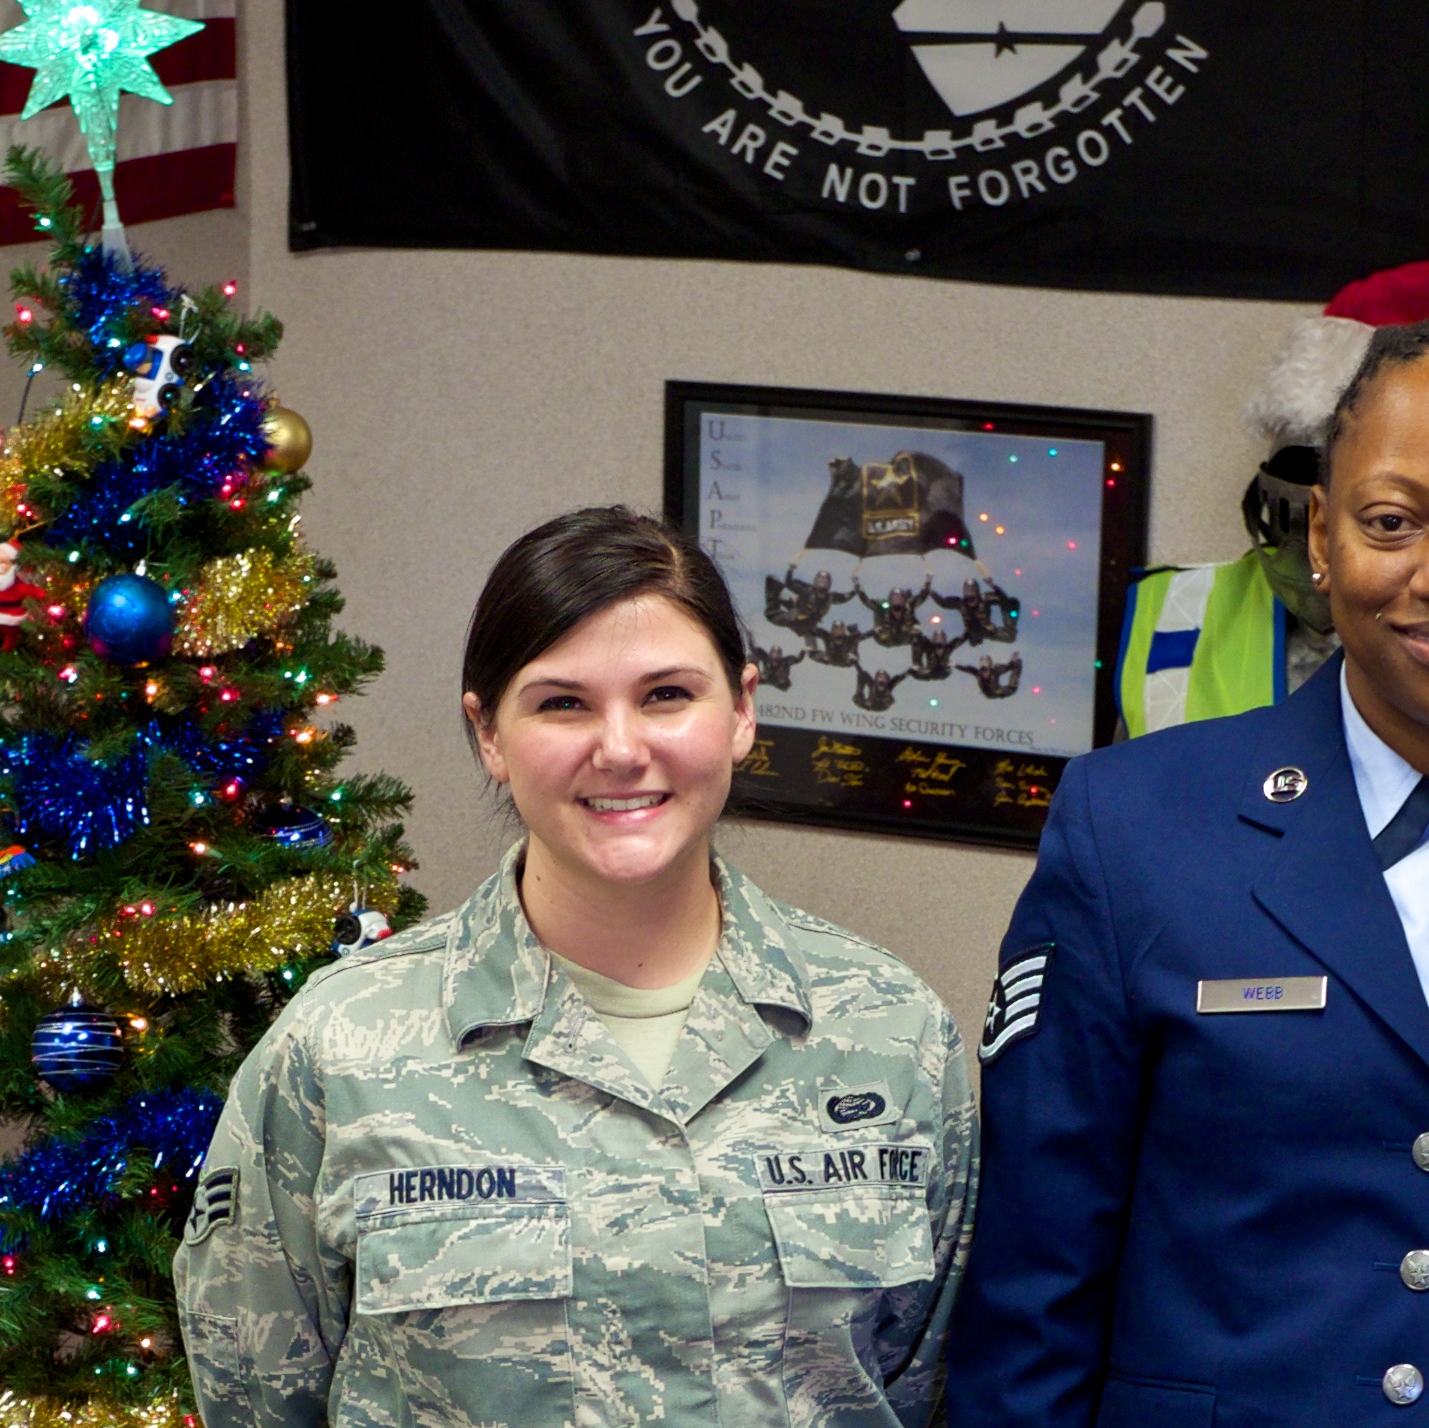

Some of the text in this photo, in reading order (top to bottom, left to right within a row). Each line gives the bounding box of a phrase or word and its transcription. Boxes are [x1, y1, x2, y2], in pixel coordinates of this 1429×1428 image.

[633, 7, 1211, 214] YOU ARE NOT FORGOTTEN
[811, 709, 836, 724] FW
[840, 712, 887, 730] WING
[890, 717, 968, 740] SECURITY
[973, 726, 1034, 746] FORCES
[1242, 986, 1284, 1000] WEBB
[389, 1169, 518, 1204] HERNDON
[768, 1150, 870, 1187] U.S. AIR
